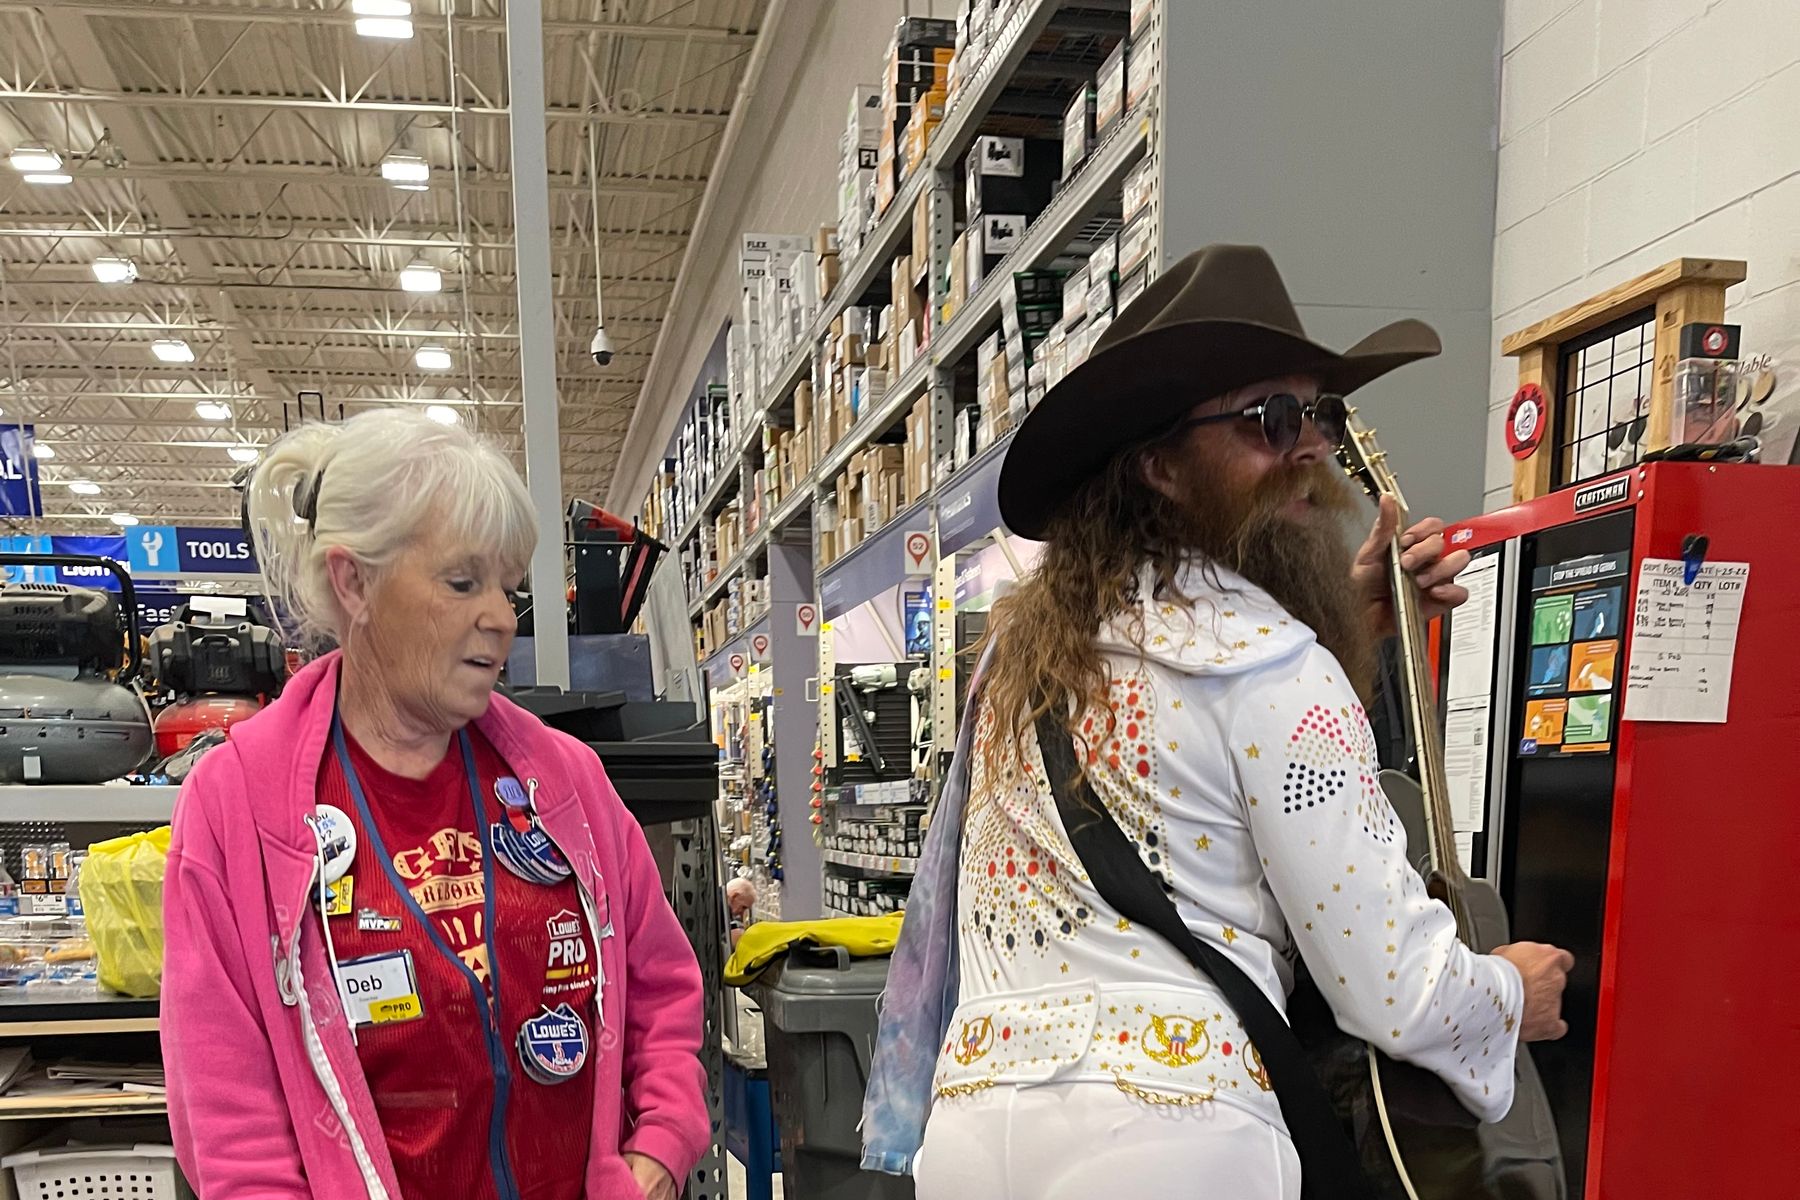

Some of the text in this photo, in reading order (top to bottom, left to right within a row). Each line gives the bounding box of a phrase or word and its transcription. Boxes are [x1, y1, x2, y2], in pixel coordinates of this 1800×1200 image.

[746, 240, 768, 249] FLEX
[1576, 482, 1625, 507] CRAFTSMAN
[186, 541, 250, 559] TOOLS
[1694, 581, 1712, 589] QTY
[551, 918, 581, 936] LOWE'S
[547, 937, 588, 968] PRO
[346, 974, 383, 995] Deb
[393, 1002, 412, 1013] PRO
[531, 1021, 578, 1039] LOWE'S
